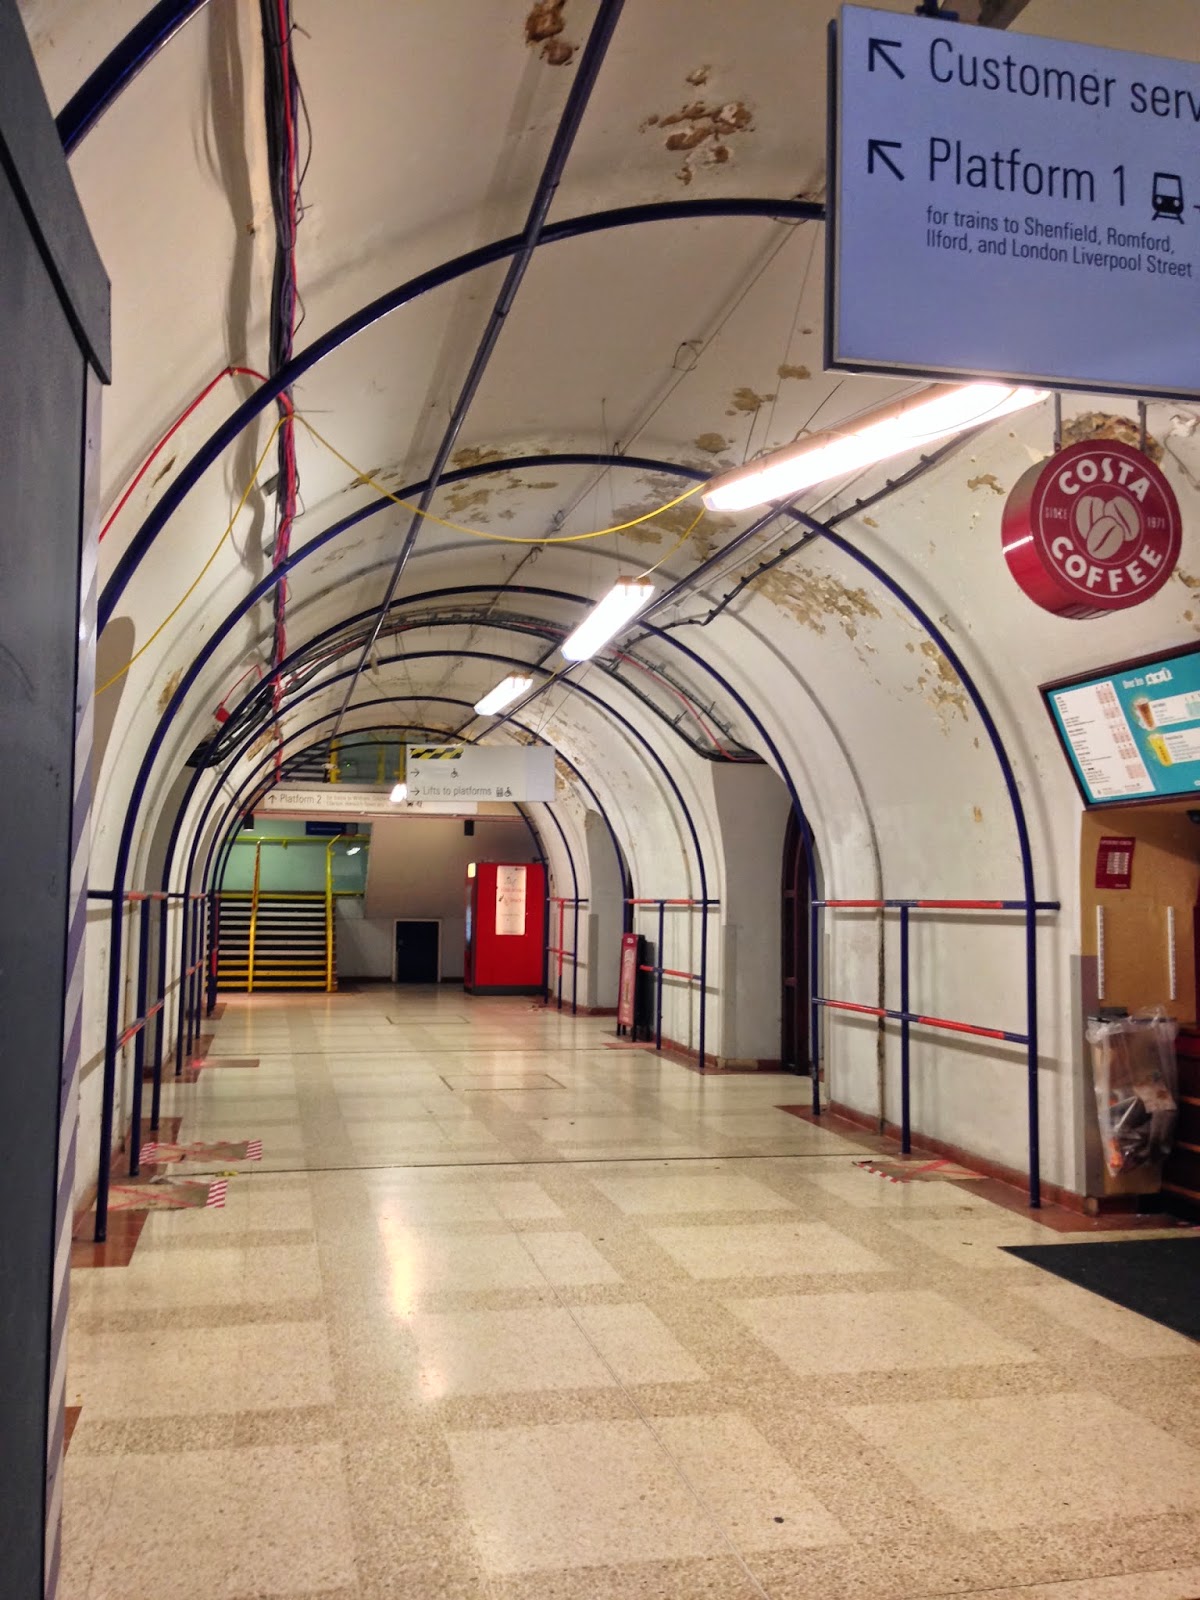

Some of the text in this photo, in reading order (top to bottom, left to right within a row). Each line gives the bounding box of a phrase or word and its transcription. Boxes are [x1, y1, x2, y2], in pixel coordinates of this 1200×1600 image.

[929, 37, 1116, 108] Customer
[929, 136, 1125, 206] Platform 1
[927, 205, 1174, 254] for trains to Shenfield, Romford,
[927, 229, 1193, 278] Ilford, and London Liverpool Street
[1058, 457, 1151, 502] COSTA
[1051, 536, 1162, 592] COFFEE
[280, 793, 315, 804] Platform
[316, 794, 322, 805] 2
[422, 785, 492, 797] Lifts to platforms
